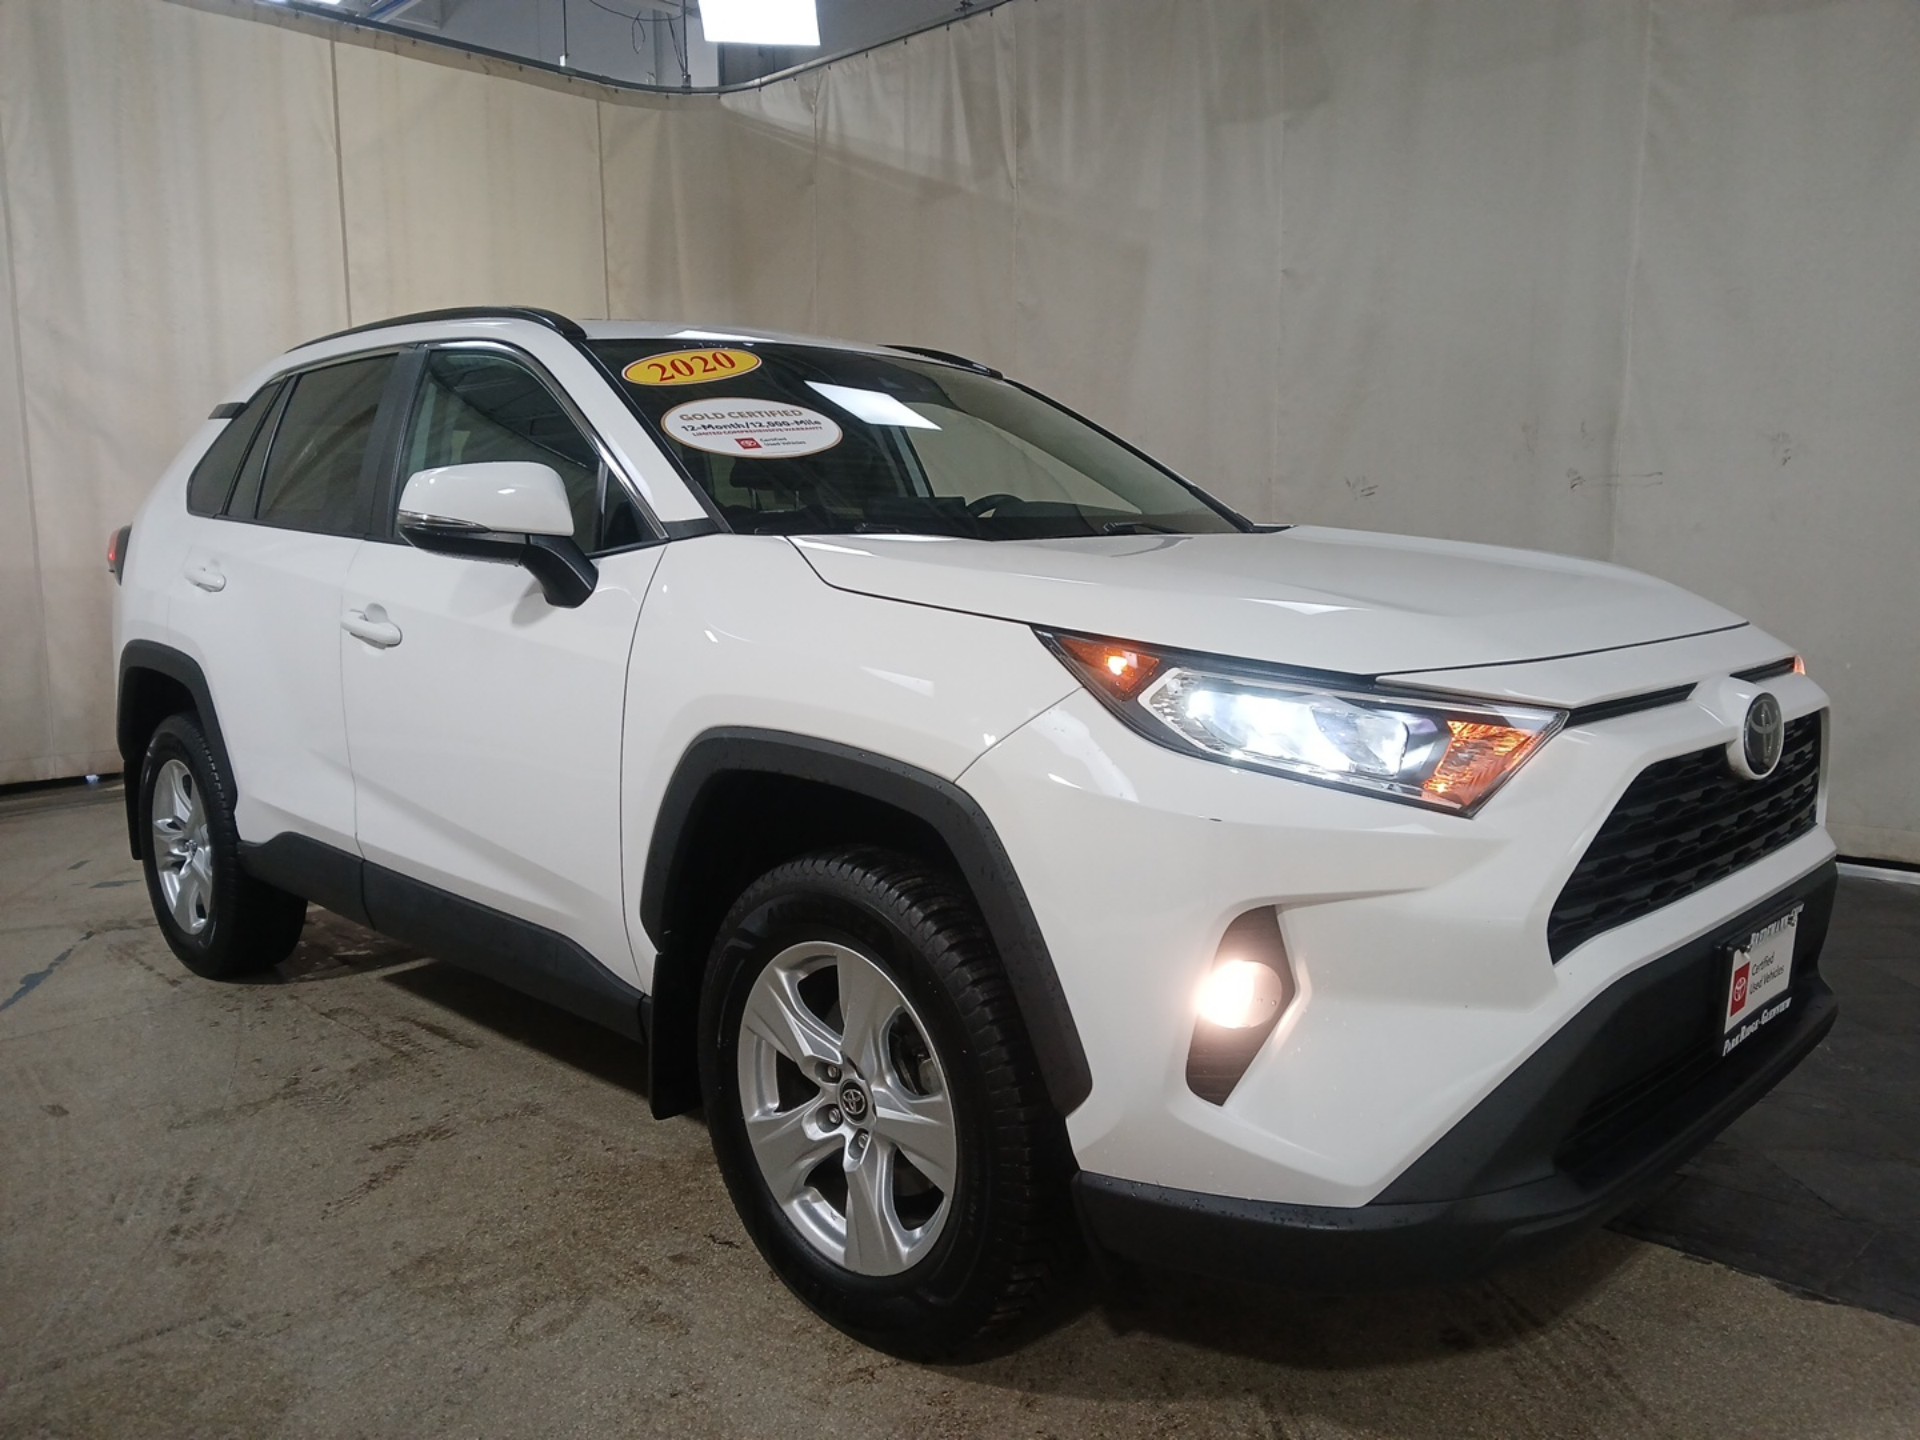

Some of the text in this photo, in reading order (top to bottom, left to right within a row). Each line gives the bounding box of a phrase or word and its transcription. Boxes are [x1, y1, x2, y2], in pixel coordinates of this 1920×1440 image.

[647, 351, 736, 382] 2020
[679, 409, 803, 421] GOLD CERTIFIED
[1751, 952, 1775, 976] Certified
[1749, 965, 1785, 995] Used Vehicles
